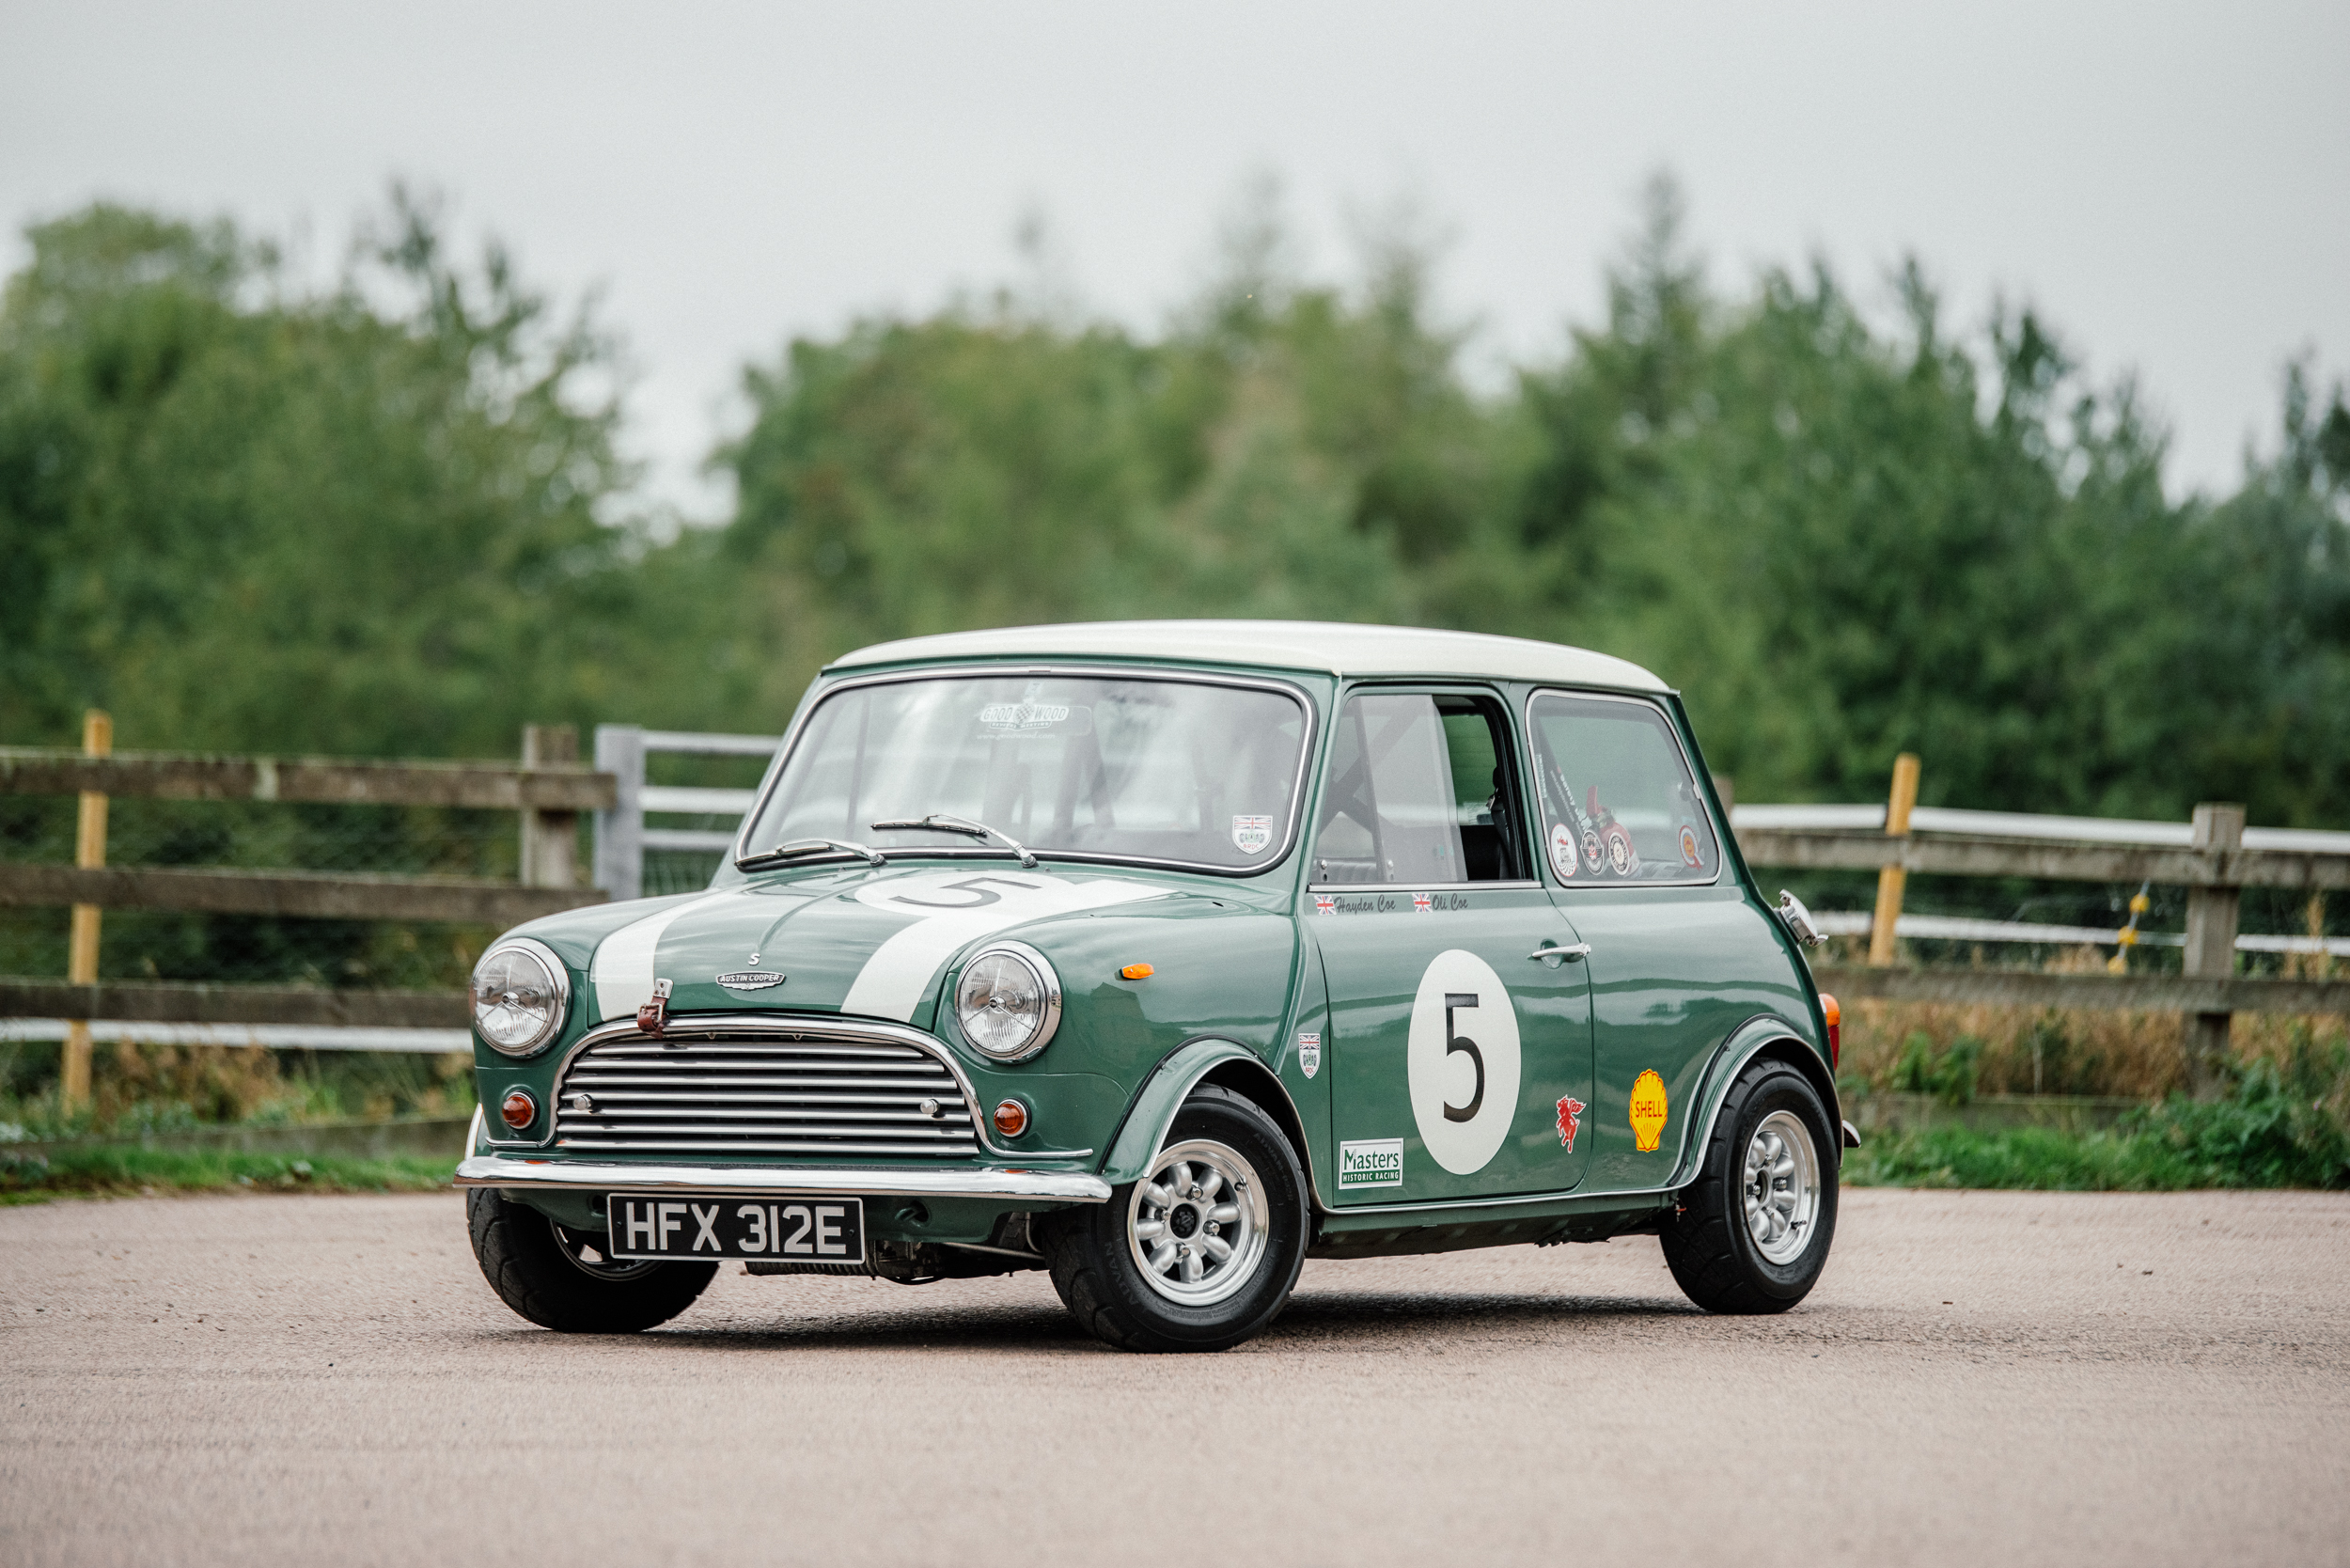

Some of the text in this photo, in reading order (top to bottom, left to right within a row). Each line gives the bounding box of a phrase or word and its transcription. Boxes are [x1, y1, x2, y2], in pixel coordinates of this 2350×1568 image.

[983, 705, 1067, 721] GOOD WOOD
[978, 731, 1056, 741] www.goodwood.com
[887, 877, 1042, 908] 5
[1334, 894, 1396, 915] Hayden Coe
[1432, 893, 1468, 911] Oli Coe
[747, 952, 760, 965] S
[749, 974, 779, 982] COOPER
[1444, 993, 1484, 1122] 5
[1636, 1100, 1662, 1118] SHELL
[1344, 1149, 1399, 1170] Masters
[1343, 1171, 1399, 1182] HISTORIC RACING
[626, 1201, 846, 1254] HFX 312E
